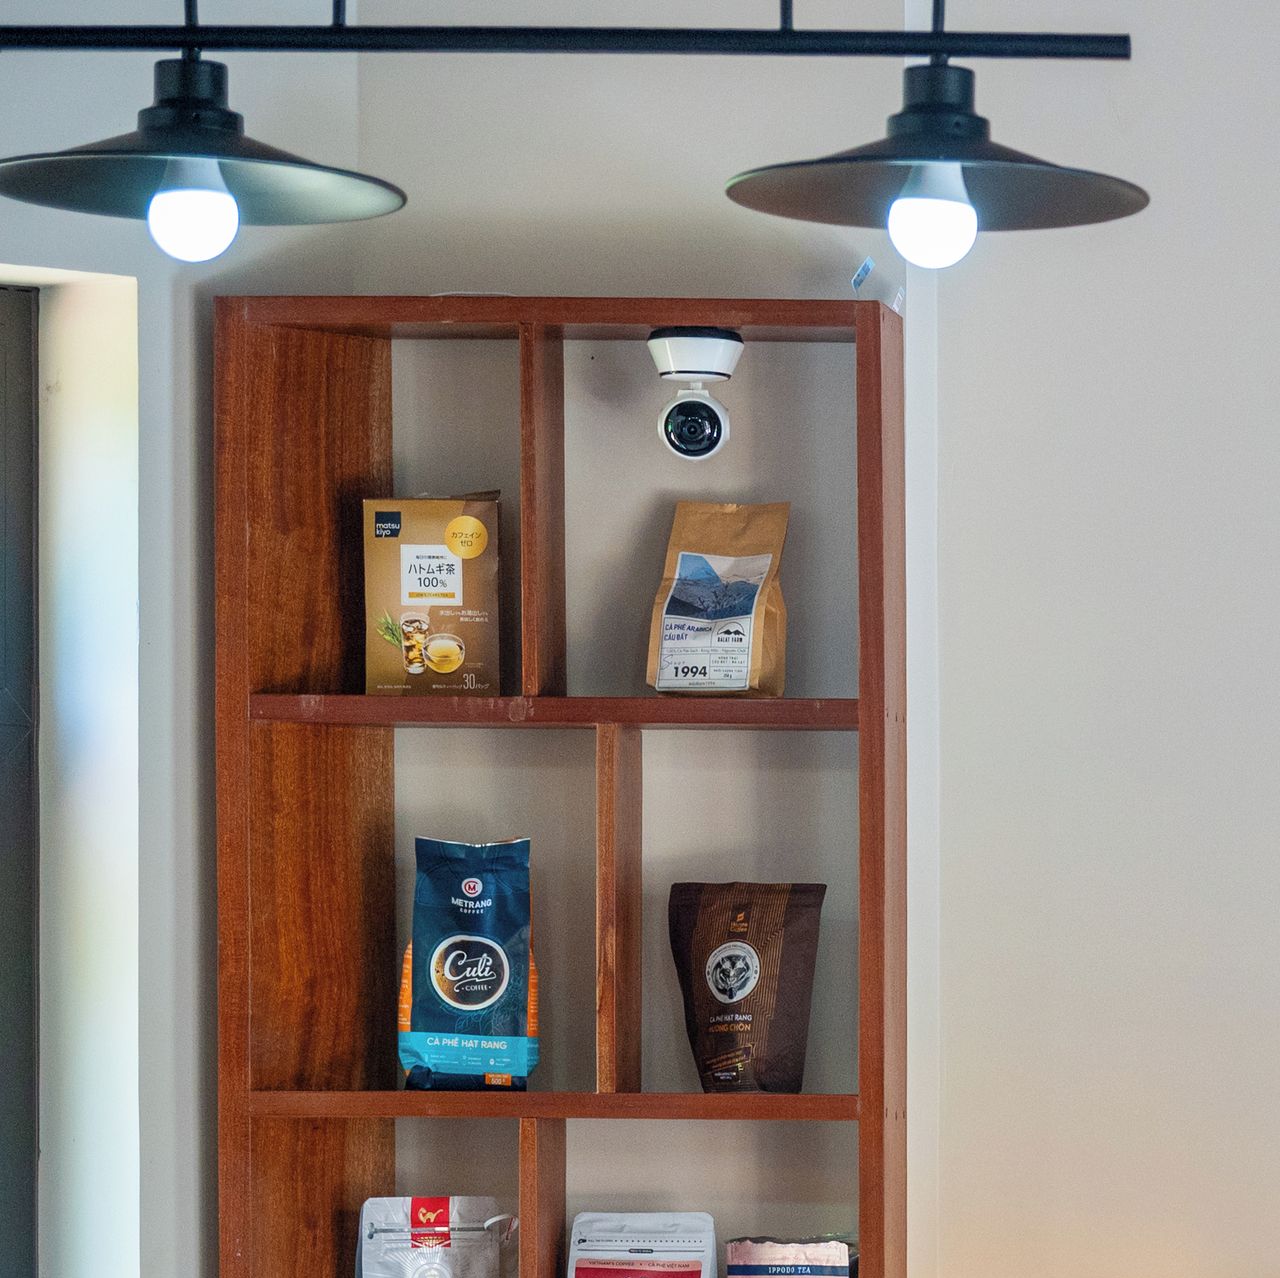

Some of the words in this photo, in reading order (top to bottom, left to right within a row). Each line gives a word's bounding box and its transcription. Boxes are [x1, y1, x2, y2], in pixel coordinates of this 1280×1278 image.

[376, 529, 391, 538] kiyo
[408, 563, 456, 575] ハトムギ茶
[417, 577, 448, 588] 100%
[674, 666, 707, 678] 1994
[444, 950, 497, 982] Culi
[734, 1013, 752, 1021] RANG
[481, 1040, 507, 1049] RANG
